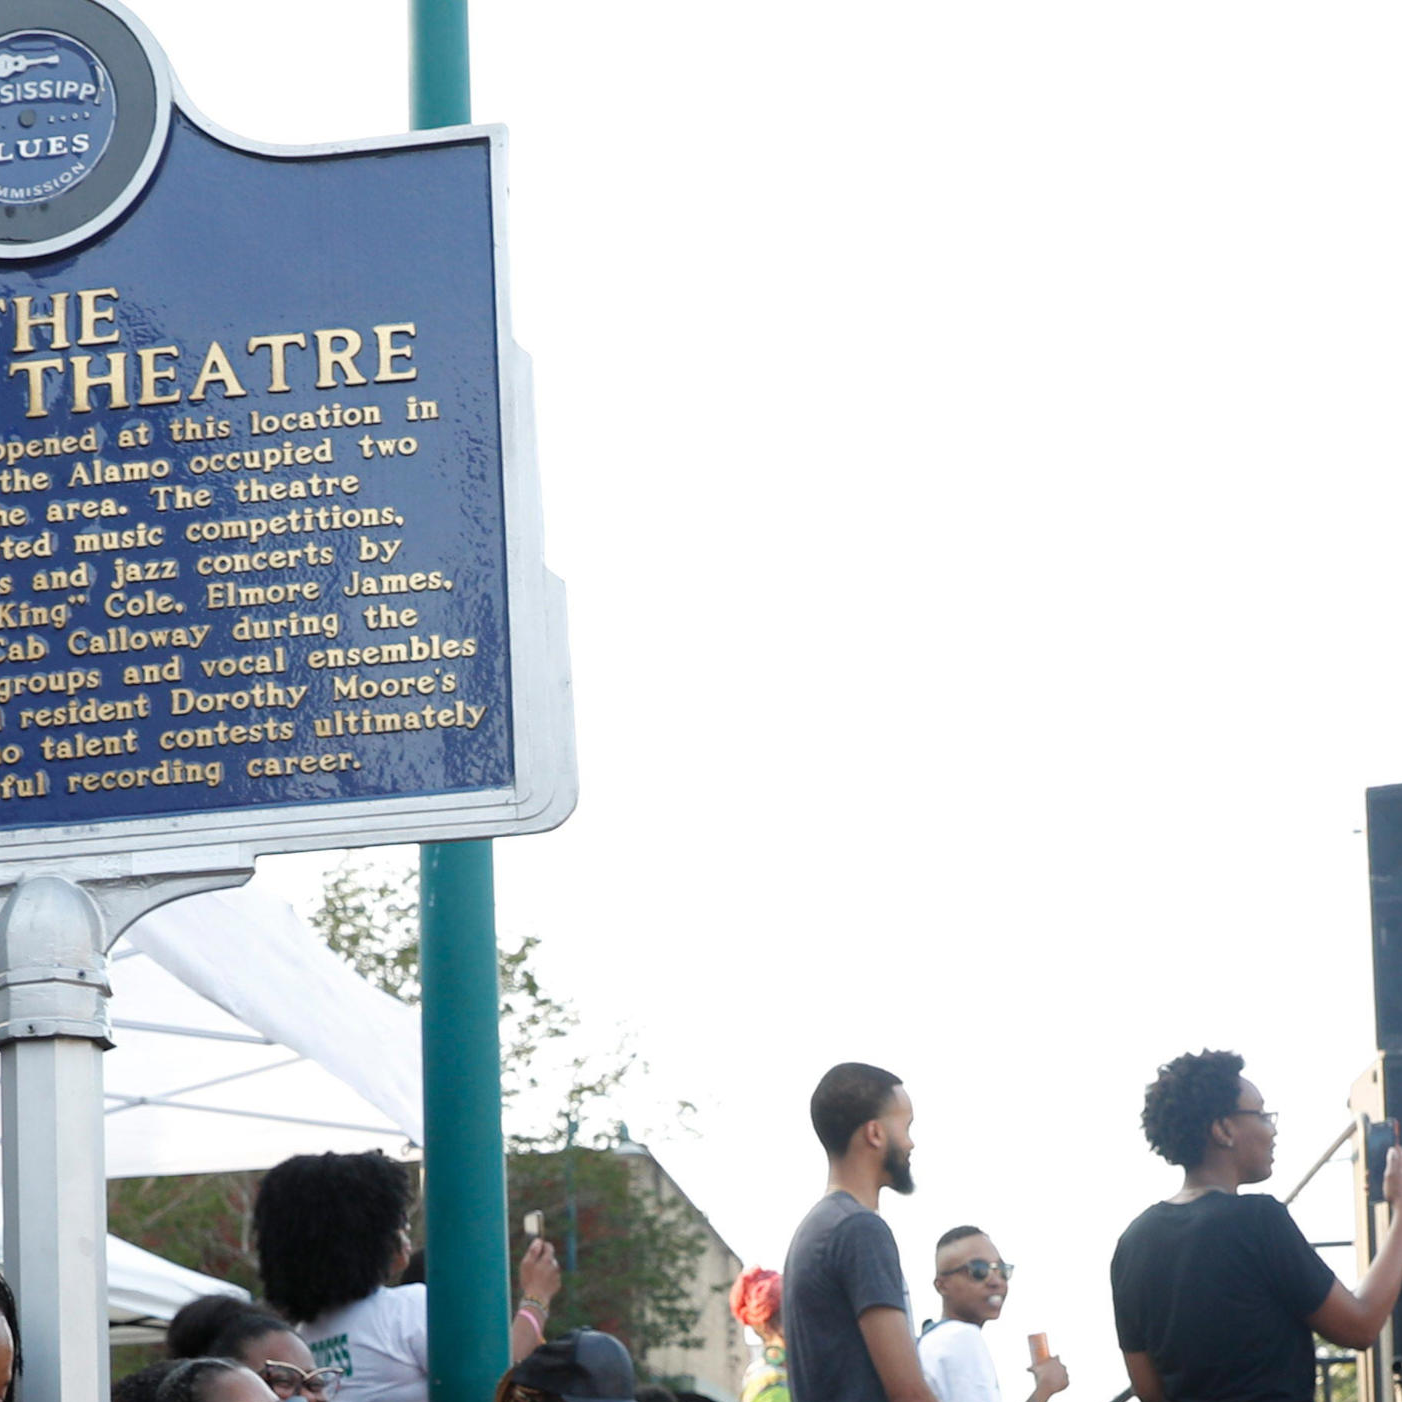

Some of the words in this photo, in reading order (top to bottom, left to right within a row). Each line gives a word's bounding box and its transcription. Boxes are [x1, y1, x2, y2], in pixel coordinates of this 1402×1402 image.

[8, 323, 418, 418] THEATRE
[117, 423, 149, 448] at
[169, 415, 232, 442] this
[250, 403, 382, 435] location
[407, 396, 439, 421] in
[68, 459, 171, 488] Alamo
[189, 437, 333, 475] occupied
[359, 435, 419, 459] two
[45, 498, 129, 523] area.
[149, 485, 212, 512] The
[234, 474, 360, 503] theatre
[73, 522, 164, 554] music
[185, 505, 405, 544] competitions,
[32, 562, 90, 592] and
[110, 558, 177, 591] jazz
[196, 542, 335, 576] concerts
[359, 535, 402, 564] by
[103, 590, 185, 619] Cole,
[206, 581, 320, 610] Elmore
[343, 571, 454, 597] James,
[67, 625, 211, 656] Calloway
[231, 611, 340, 641] during
[363, 603, 418, 630] the
[122, 655, 181, 685] and
[200, 647, 287, 677] vocal
[307, 634, 477, 670] ensembles
[19, 694, 149, 729] resident
[170, 681, 308, 716] Dorothy
[333, 668, 458, 702] Moore's
[40, 730, 138, 761] talent
[159, 717, 294, 751] contests
[313, 700, 487, 739] ultimately
[67, 759, 223, 793] recording
[245, 752, 362, 778] career.
